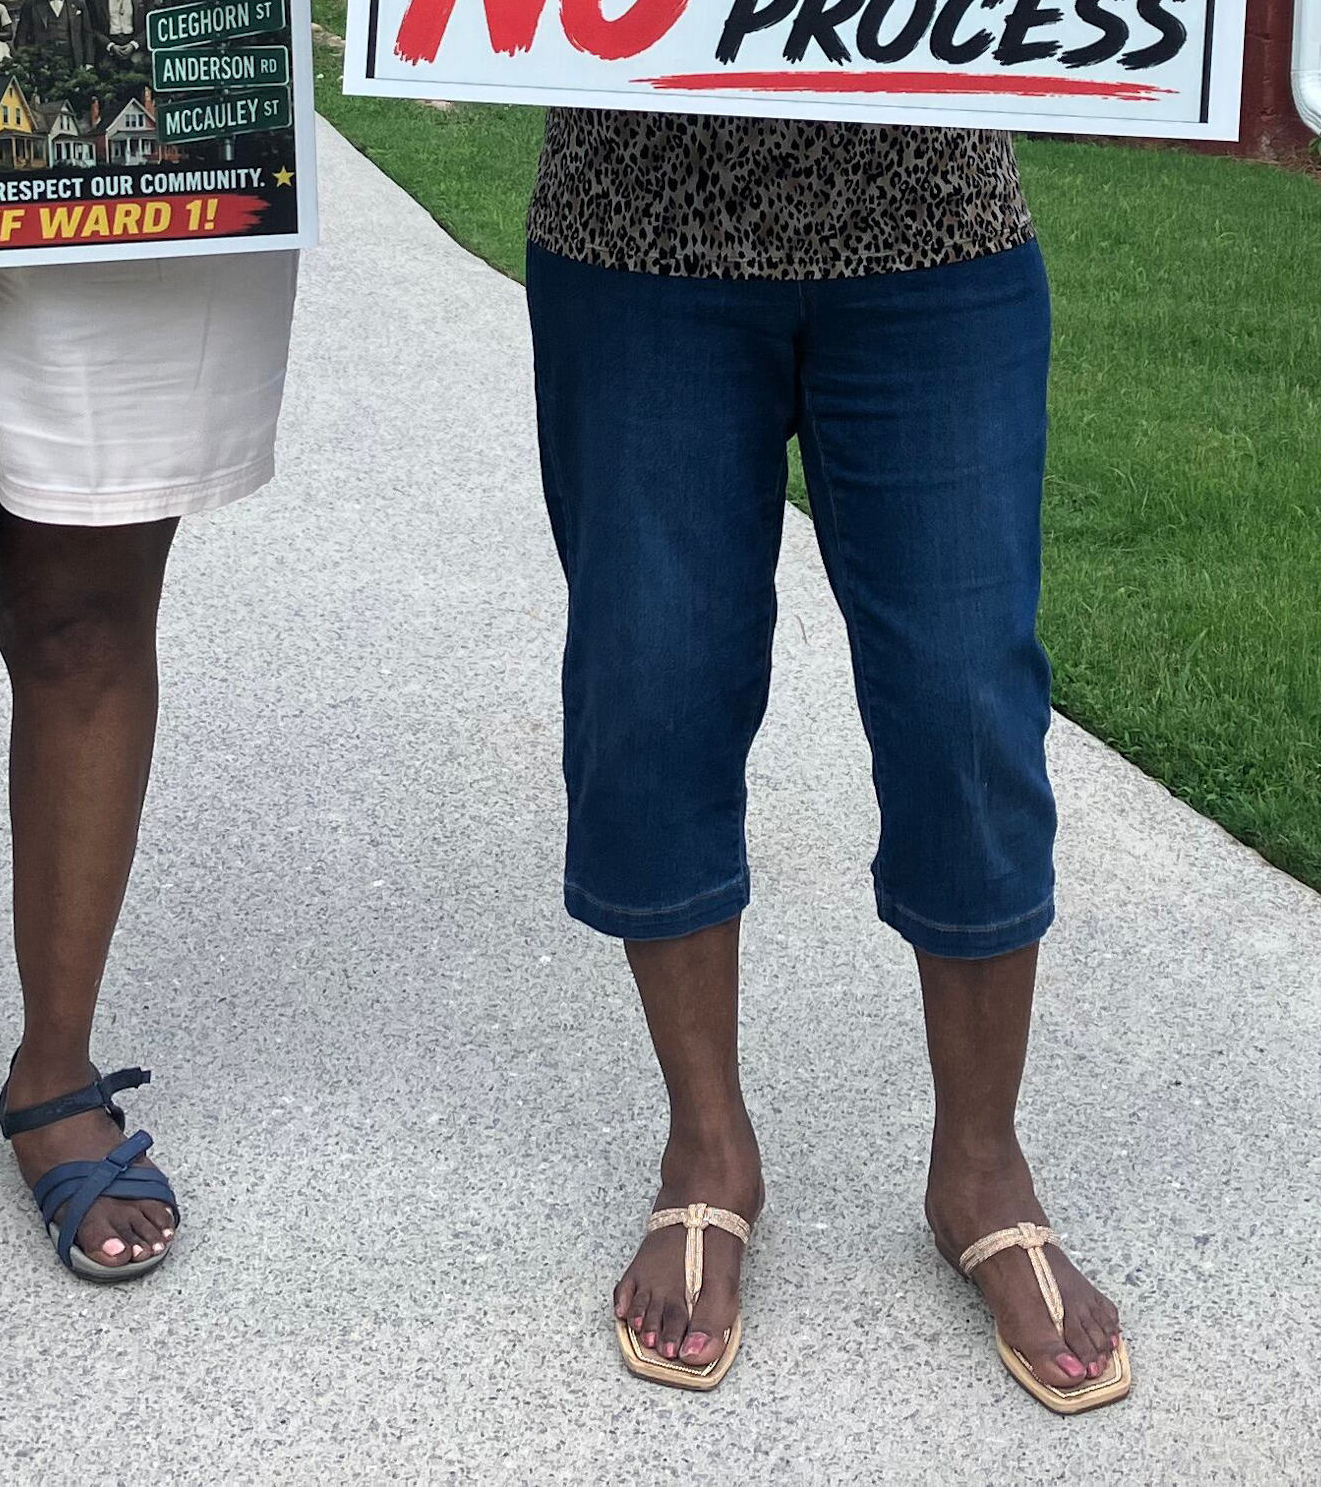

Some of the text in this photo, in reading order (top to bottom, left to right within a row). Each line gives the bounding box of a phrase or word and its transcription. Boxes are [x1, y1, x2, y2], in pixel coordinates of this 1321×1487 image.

[157, 1, 272, 42] CLEGHORN ST
[163, 55, 277, 82] ANDERSON RD
[166, 98, 279, 135] MCCAULEY ST
[91, 172, 134, 195] OUR
[140, 168, 266, 193] COMMUNITY.
[38, 200, 175, 238] WARD
[185, 198, 219, 230] 1!
